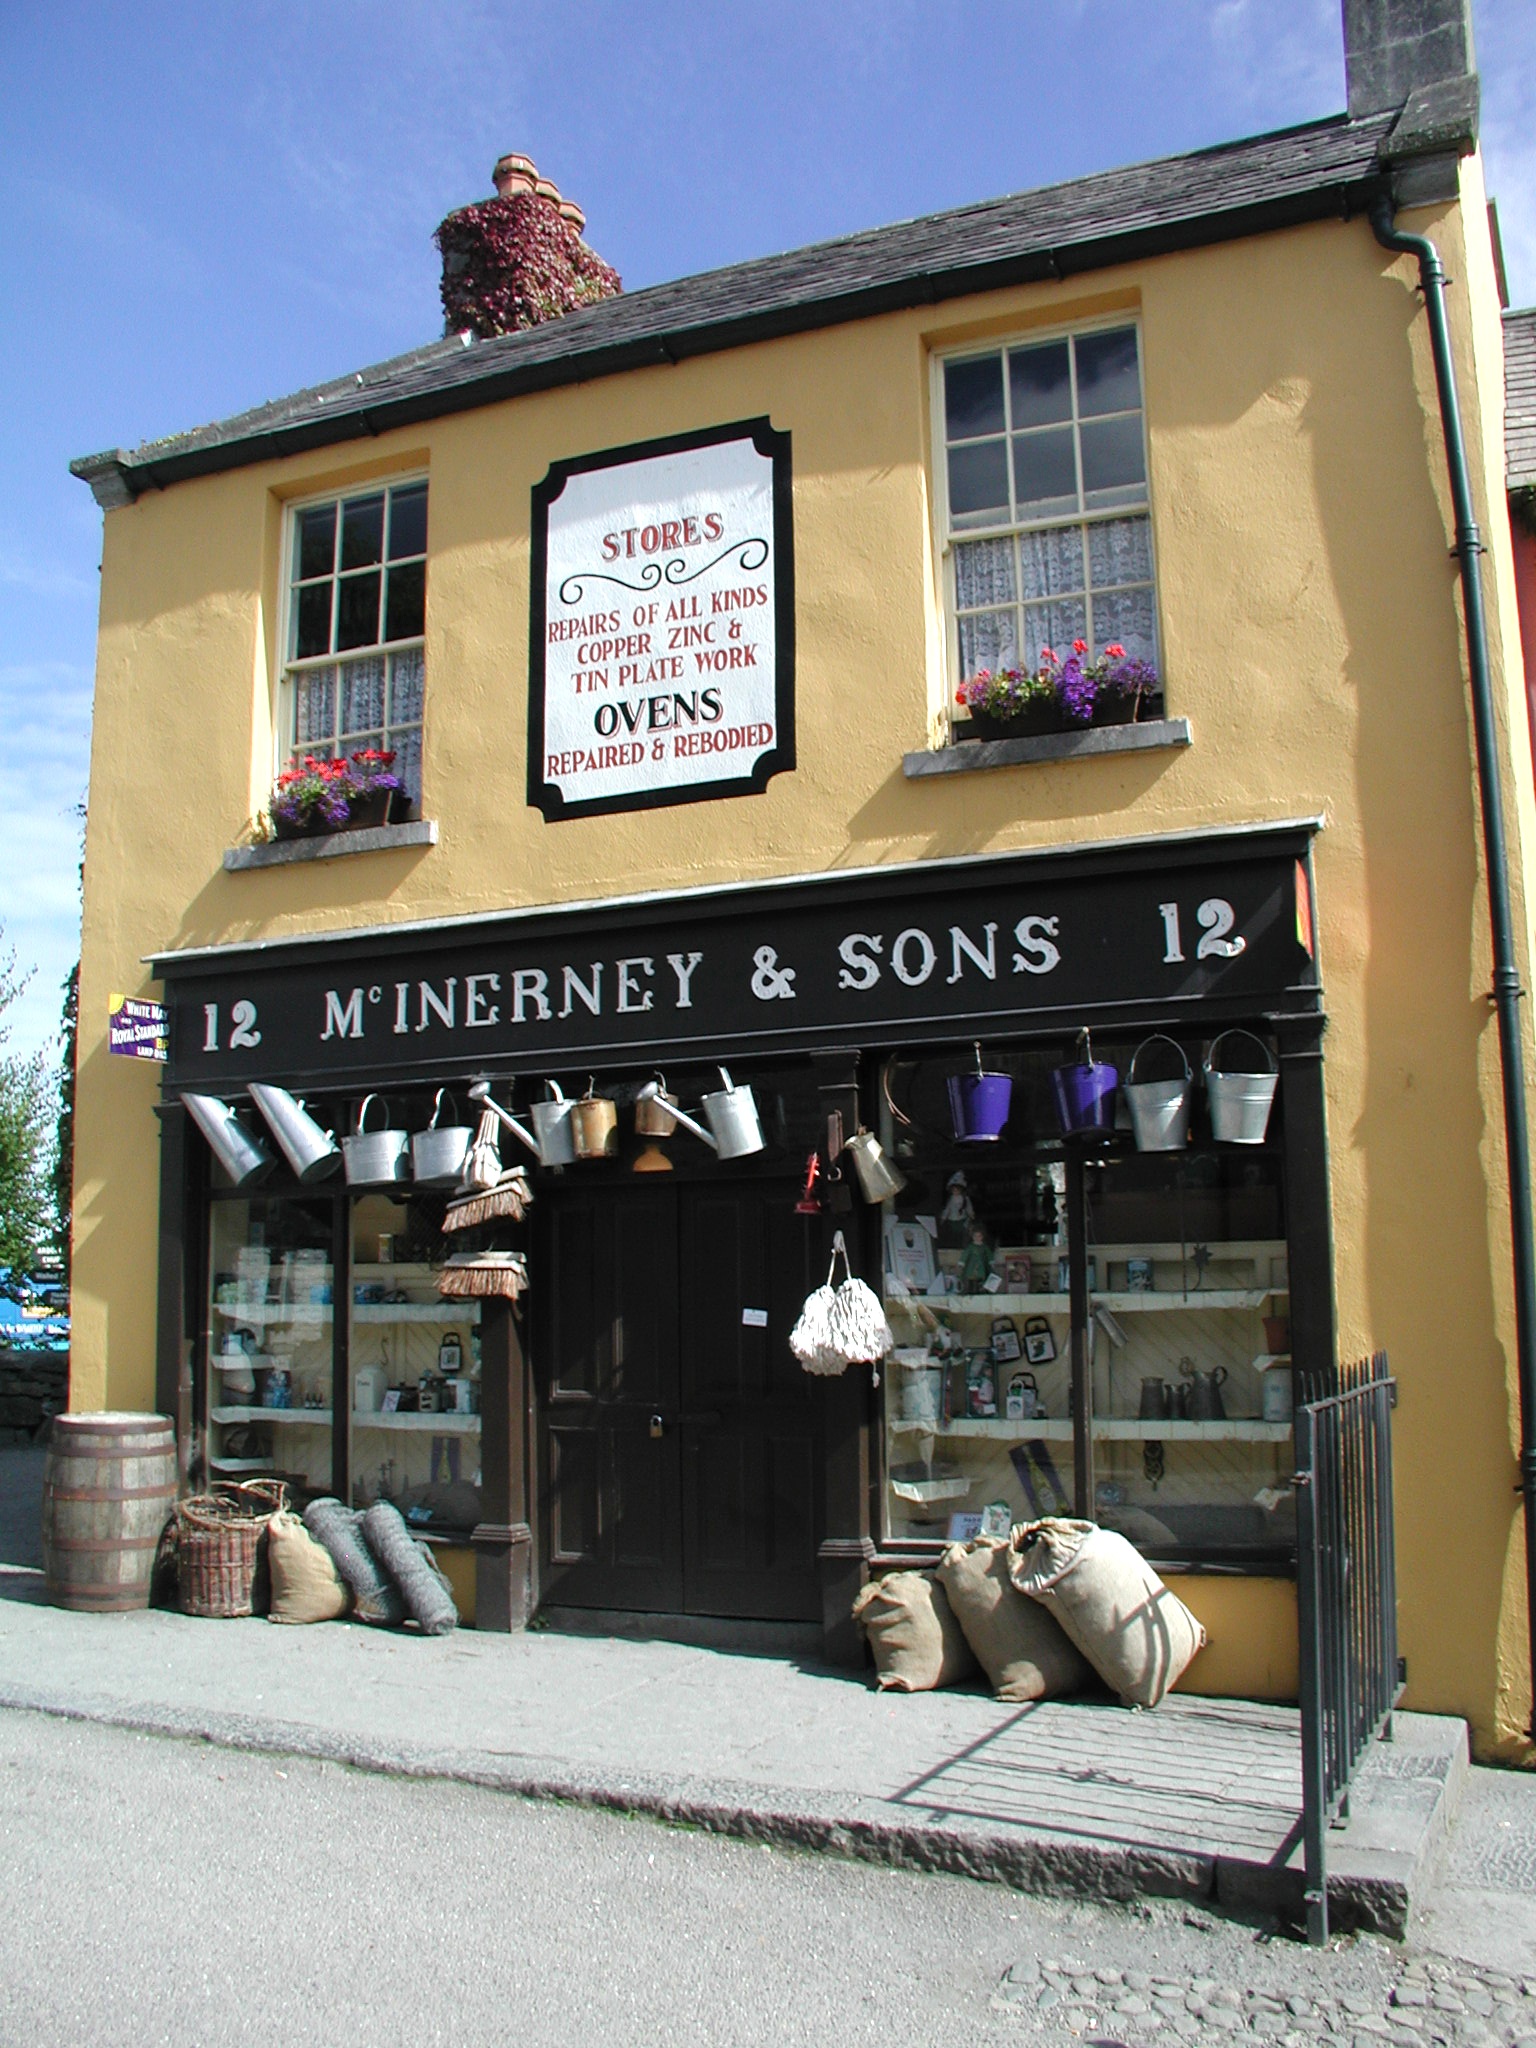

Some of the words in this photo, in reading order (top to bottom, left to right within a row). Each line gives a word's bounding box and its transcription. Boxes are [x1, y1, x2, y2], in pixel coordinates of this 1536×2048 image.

[602, 512, 724, 562] STORES
[548, 610, 621, 644] REPAIRS
[633, 601, 660, 628] OF
[665, 594, 703, 622] ALL
[711, 584, 768, 613] KINDS
[577, 633, 652, 665] COPPER
[668, 621, 716, 650] ZINC
[728, 618, 743, 639] &
[571, 668, 608, 694] TIN
[619, 656, 684, 687] PLATE
[694, 643, 758, 674] WORK
[594, 687, 724, 739] OVENS
[547, 742, 645, 778] REPAIRED
[651, 738, 665, 761] &
[673, 722, 774, 758] REBODIED
[203, 999, 262, 1052] 12
[751, 944, 797, 1001] &
[838, 915, 1062, 990] SONS
[1158, 898, 1246, 964] 12
[126, 1000, 150, 1019] WHITE
[112, 1027, 135, 1045] ROYAL
